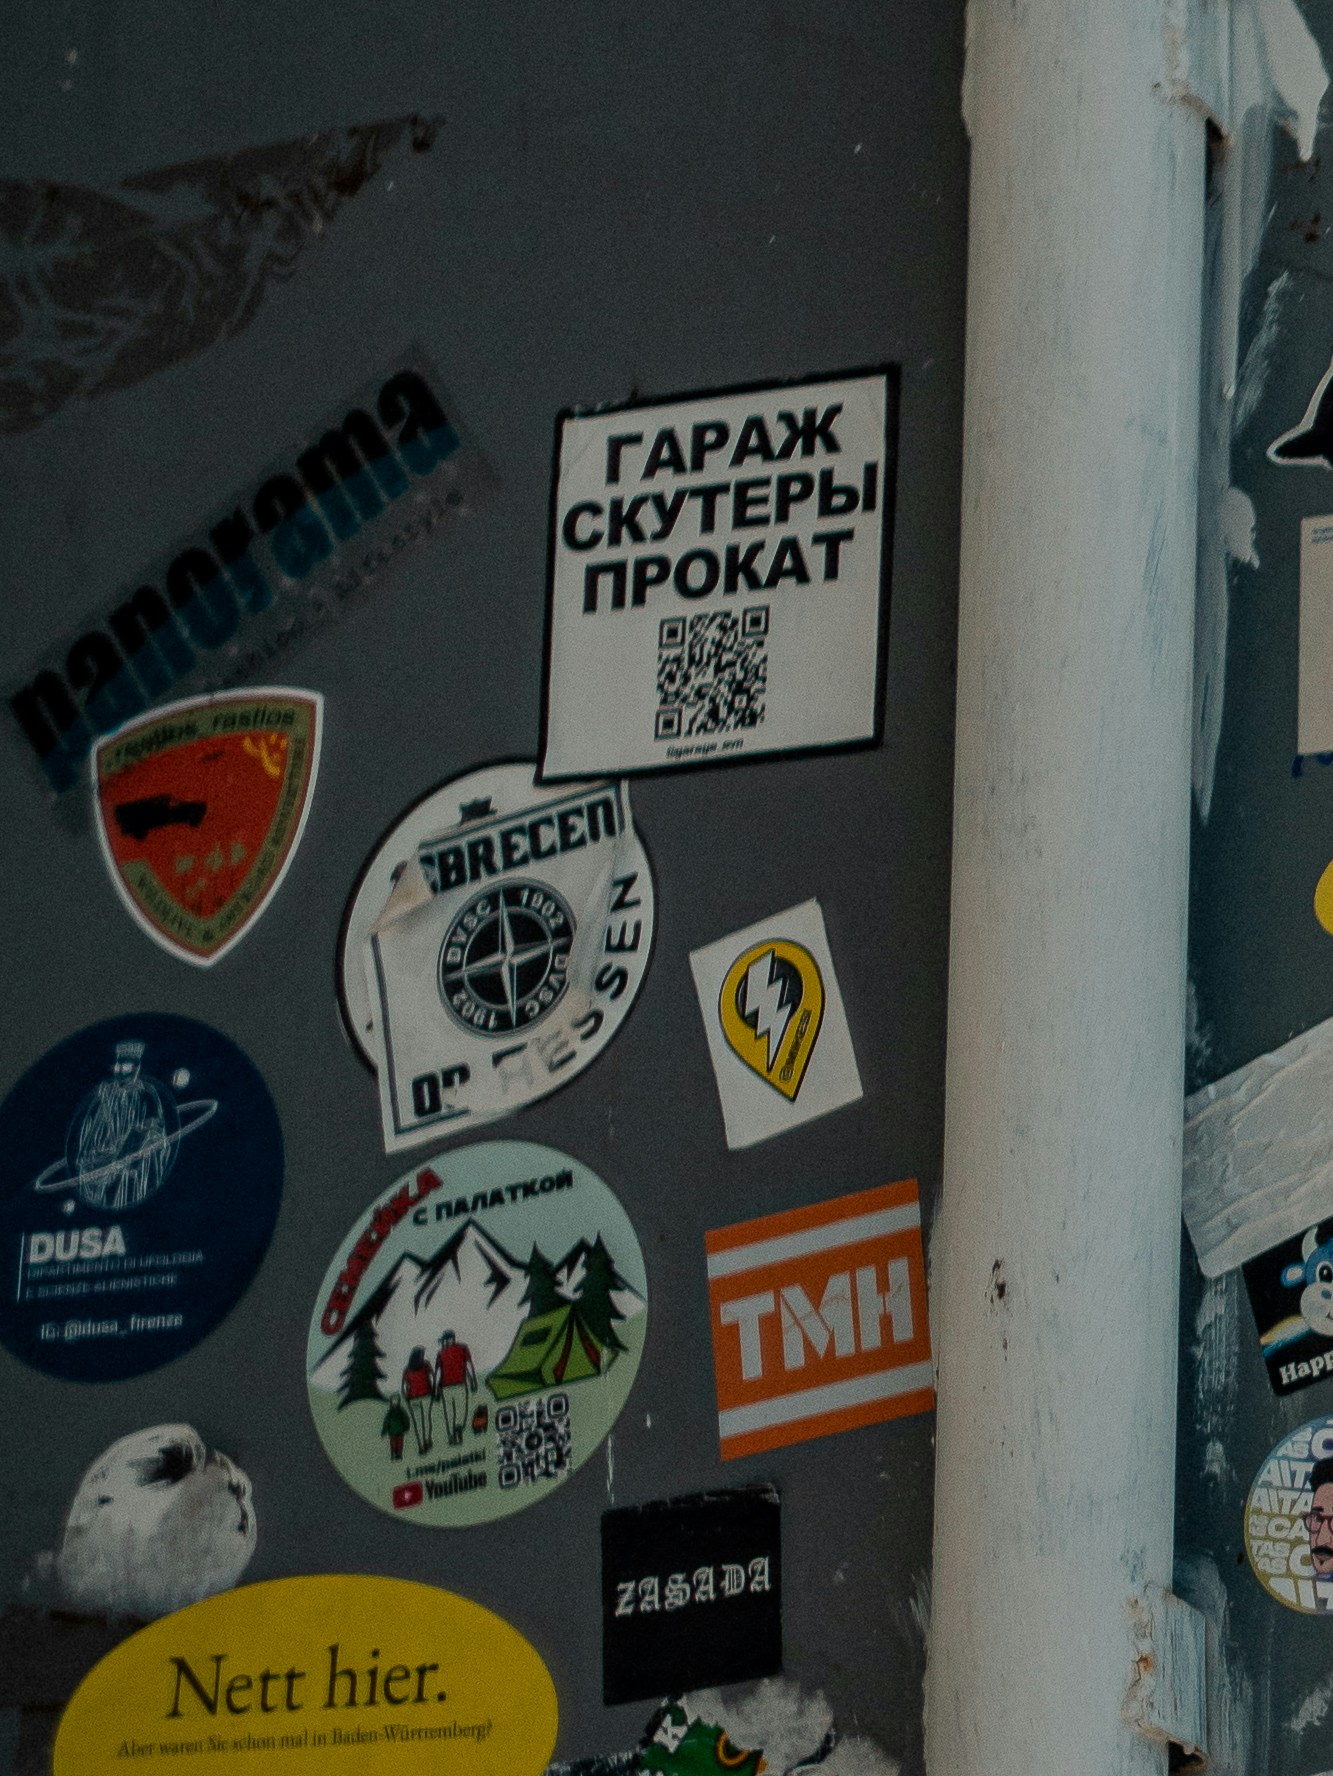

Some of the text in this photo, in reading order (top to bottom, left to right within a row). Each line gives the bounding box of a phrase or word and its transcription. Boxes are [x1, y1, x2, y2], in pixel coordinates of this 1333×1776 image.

[606, 402, 844, 486] ГАРАЖ
[563, 462, 878, 552] СКУТЕРЫ
[11, 370, 460, 794] panorama
[583, 529, 854, 614] ПРОКАТ
[28, 1225, 127, 1265] DUSA
[720, 1256, 914, 1382] TMH
[425, 1470, 487, 1501] YouTube
[614, 1555, 772, 1619] ZASADA
[166, 1642, 447, 1719] Nett hier.
[118, 1737, 156, 1759] Aber
